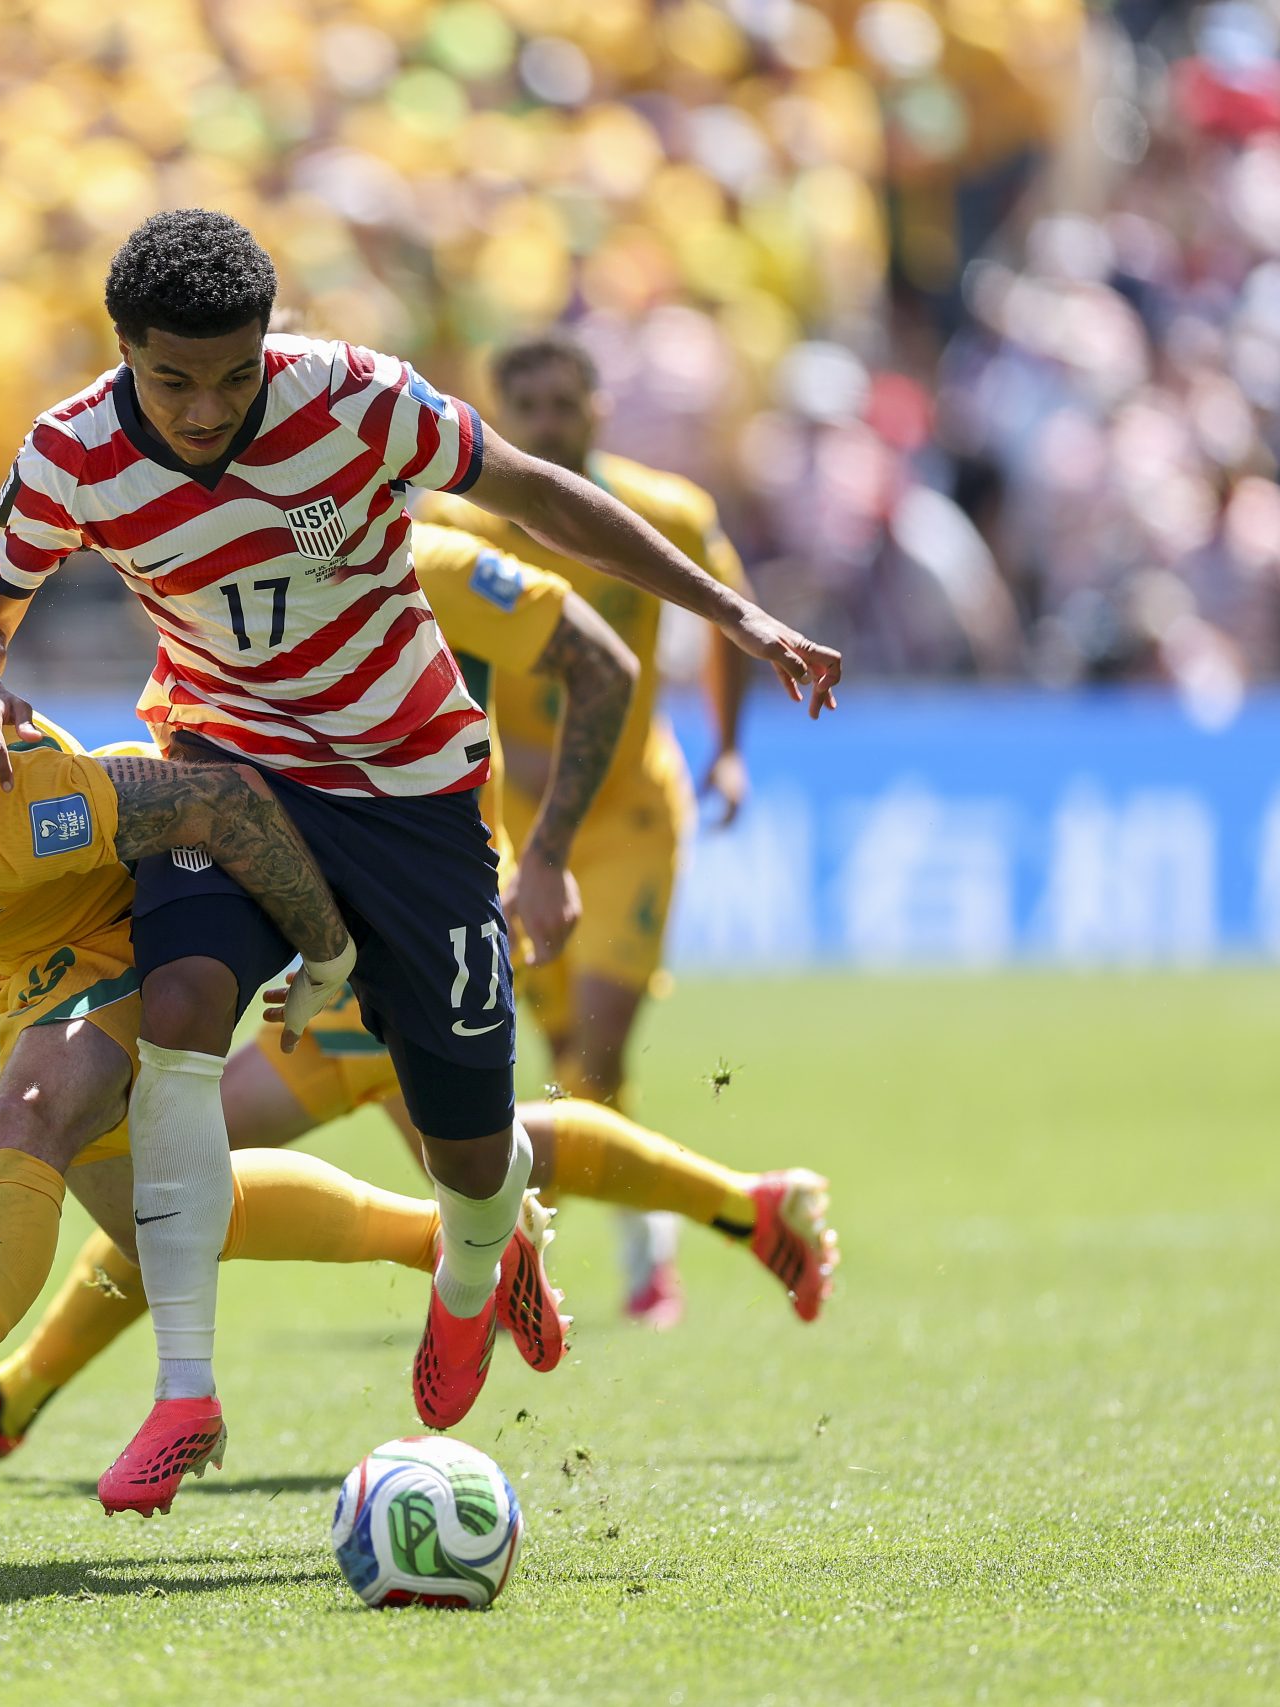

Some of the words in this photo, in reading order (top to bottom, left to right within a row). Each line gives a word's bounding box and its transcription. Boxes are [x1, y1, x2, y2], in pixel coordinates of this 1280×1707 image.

[289, 500, 335, 529] USA
[219, 576, 291, 651] 17
[59, 823, 69, 841] Unite
[66, 810, 80, 837] PEACE
